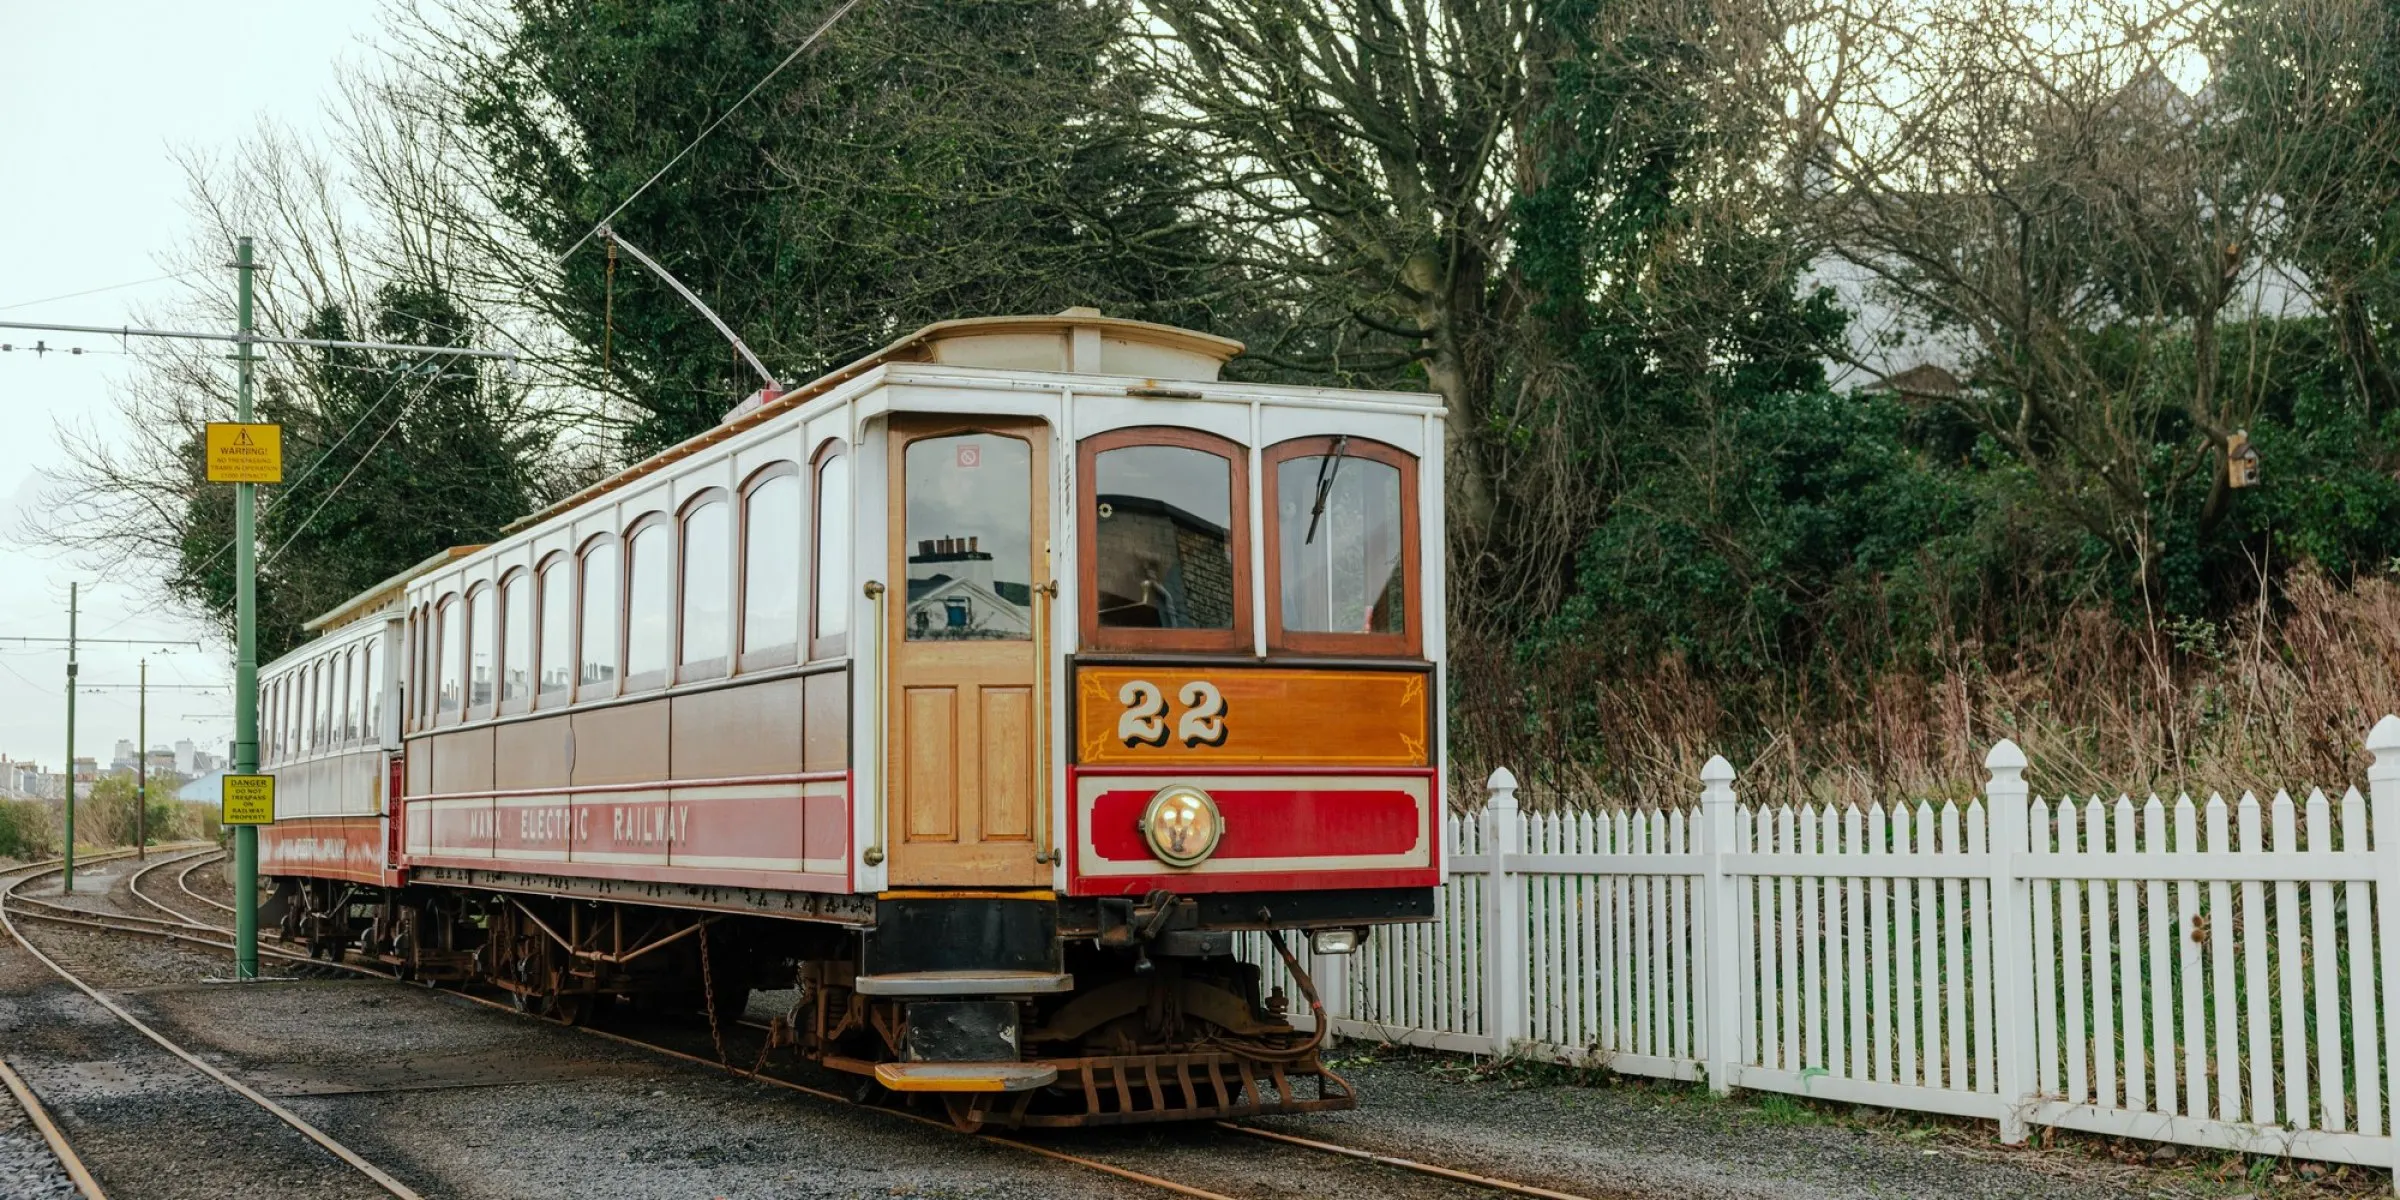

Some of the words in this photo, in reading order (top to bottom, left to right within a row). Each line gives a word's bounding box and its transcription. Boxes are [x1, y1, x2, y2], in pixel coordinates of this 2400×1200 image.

[220, 447, 268, 455] WARNING!
[1118, 680, 1228, 748] 22
[470, 809, 501, 839] MANX
[521, 807, 589, 840] ELECTRIC
[614, 806, 689, 842] RAILWAY
